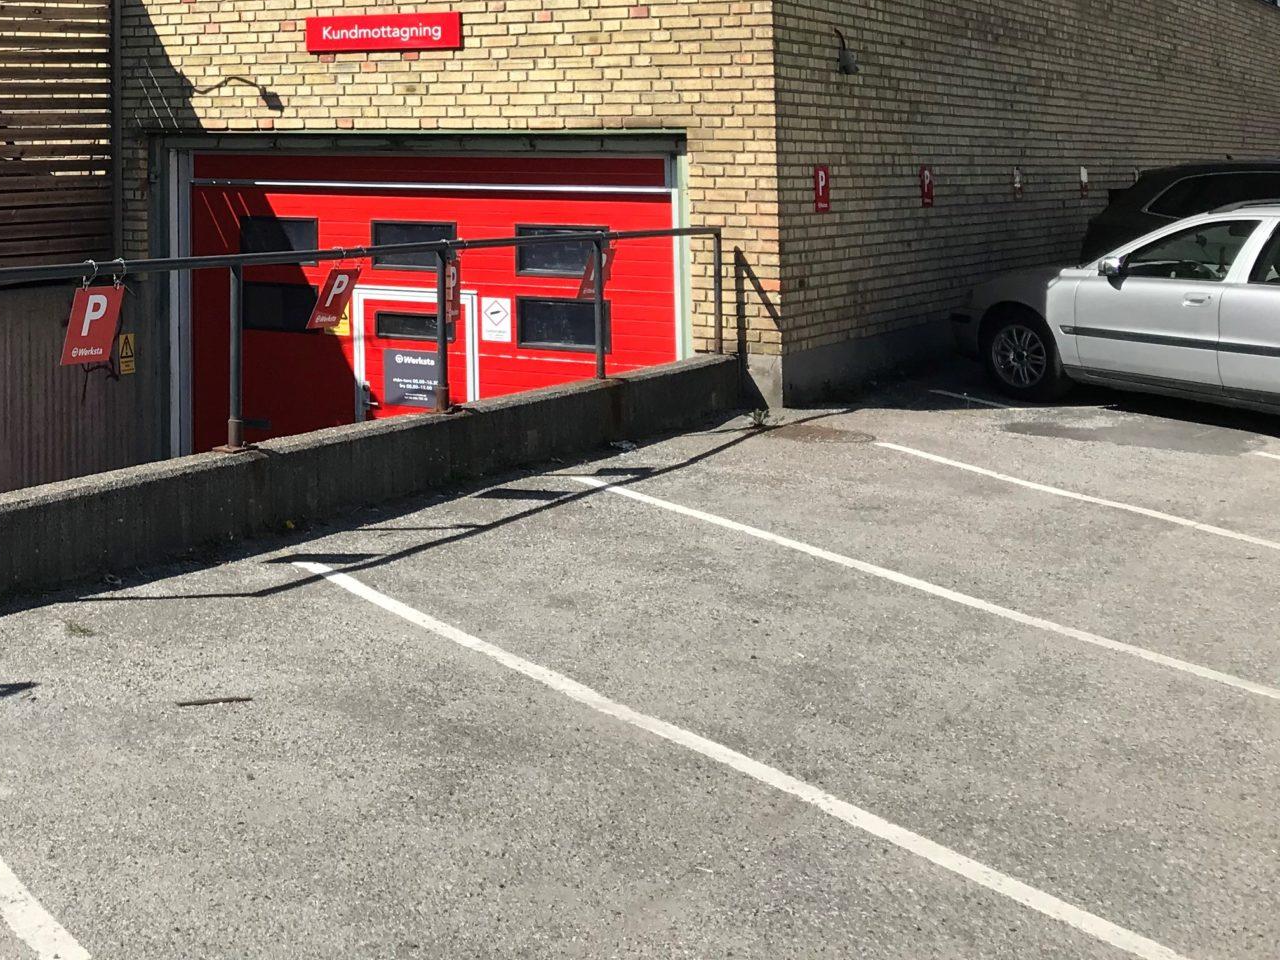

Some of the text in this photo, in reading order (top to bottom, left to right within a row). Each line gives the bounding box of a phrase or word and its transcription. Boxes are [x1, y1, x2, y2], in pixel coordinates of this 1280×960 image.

[322, 23, 442, 41] Kundmottagning
[325, 275, 350, 307] P
[81, 294, 108, 336] P
[78, 347, 103, 357] Werksta
[404, 356, 435, 365] Werksta
